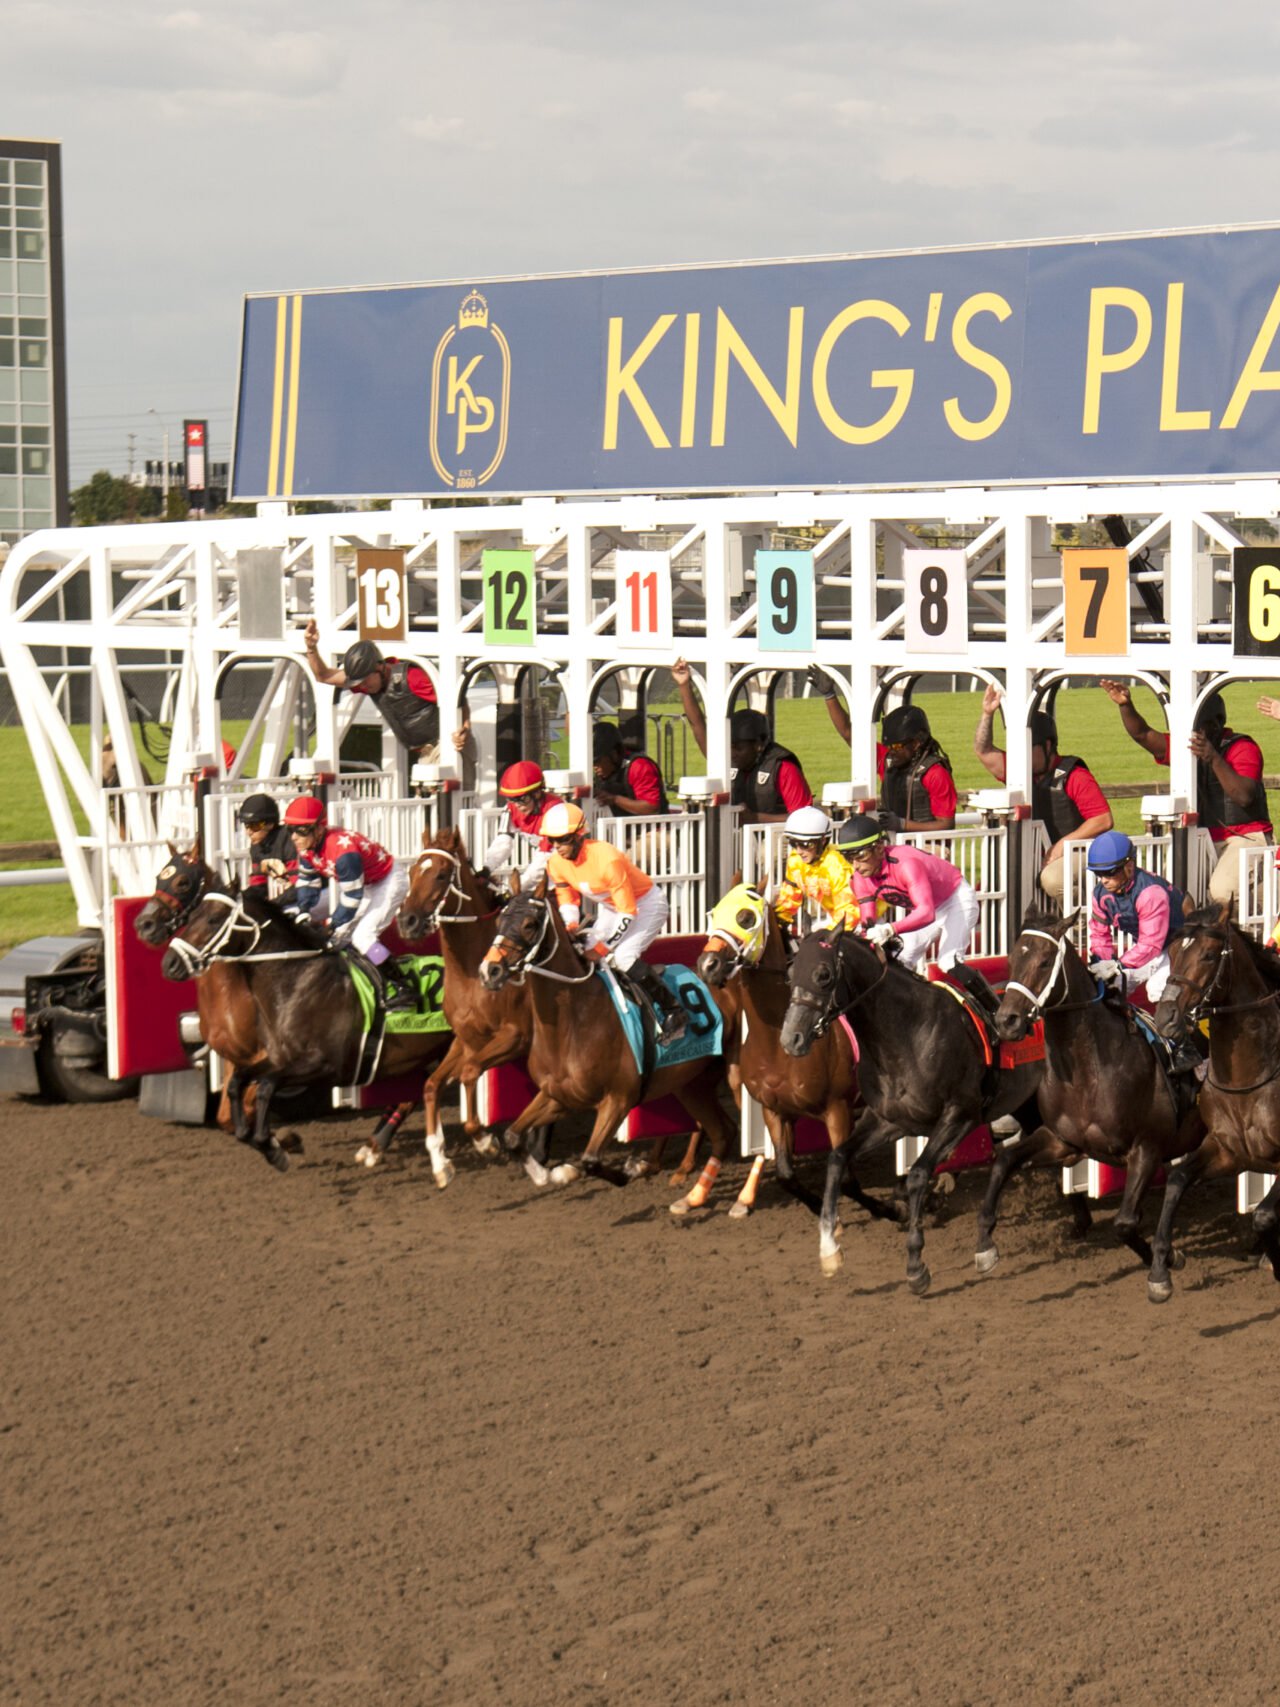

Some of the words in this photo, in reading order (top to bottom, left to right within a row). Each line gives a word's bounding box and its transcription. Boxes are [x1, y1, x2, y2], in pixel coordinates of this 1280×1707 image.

[603, 292, 1013, 450] KING'S
[456, 477, 476, 489] 1860
[361, 568, 401, 630] 13
[488, 570, 527, 630] 12
[626, 572, 657, 632] 11
[771, 567, 798, 635] 9
[920, 566, 948, 636] 8
[1079, 567, 1109, 638] 7
[679, 982, 716, 1037] 9
